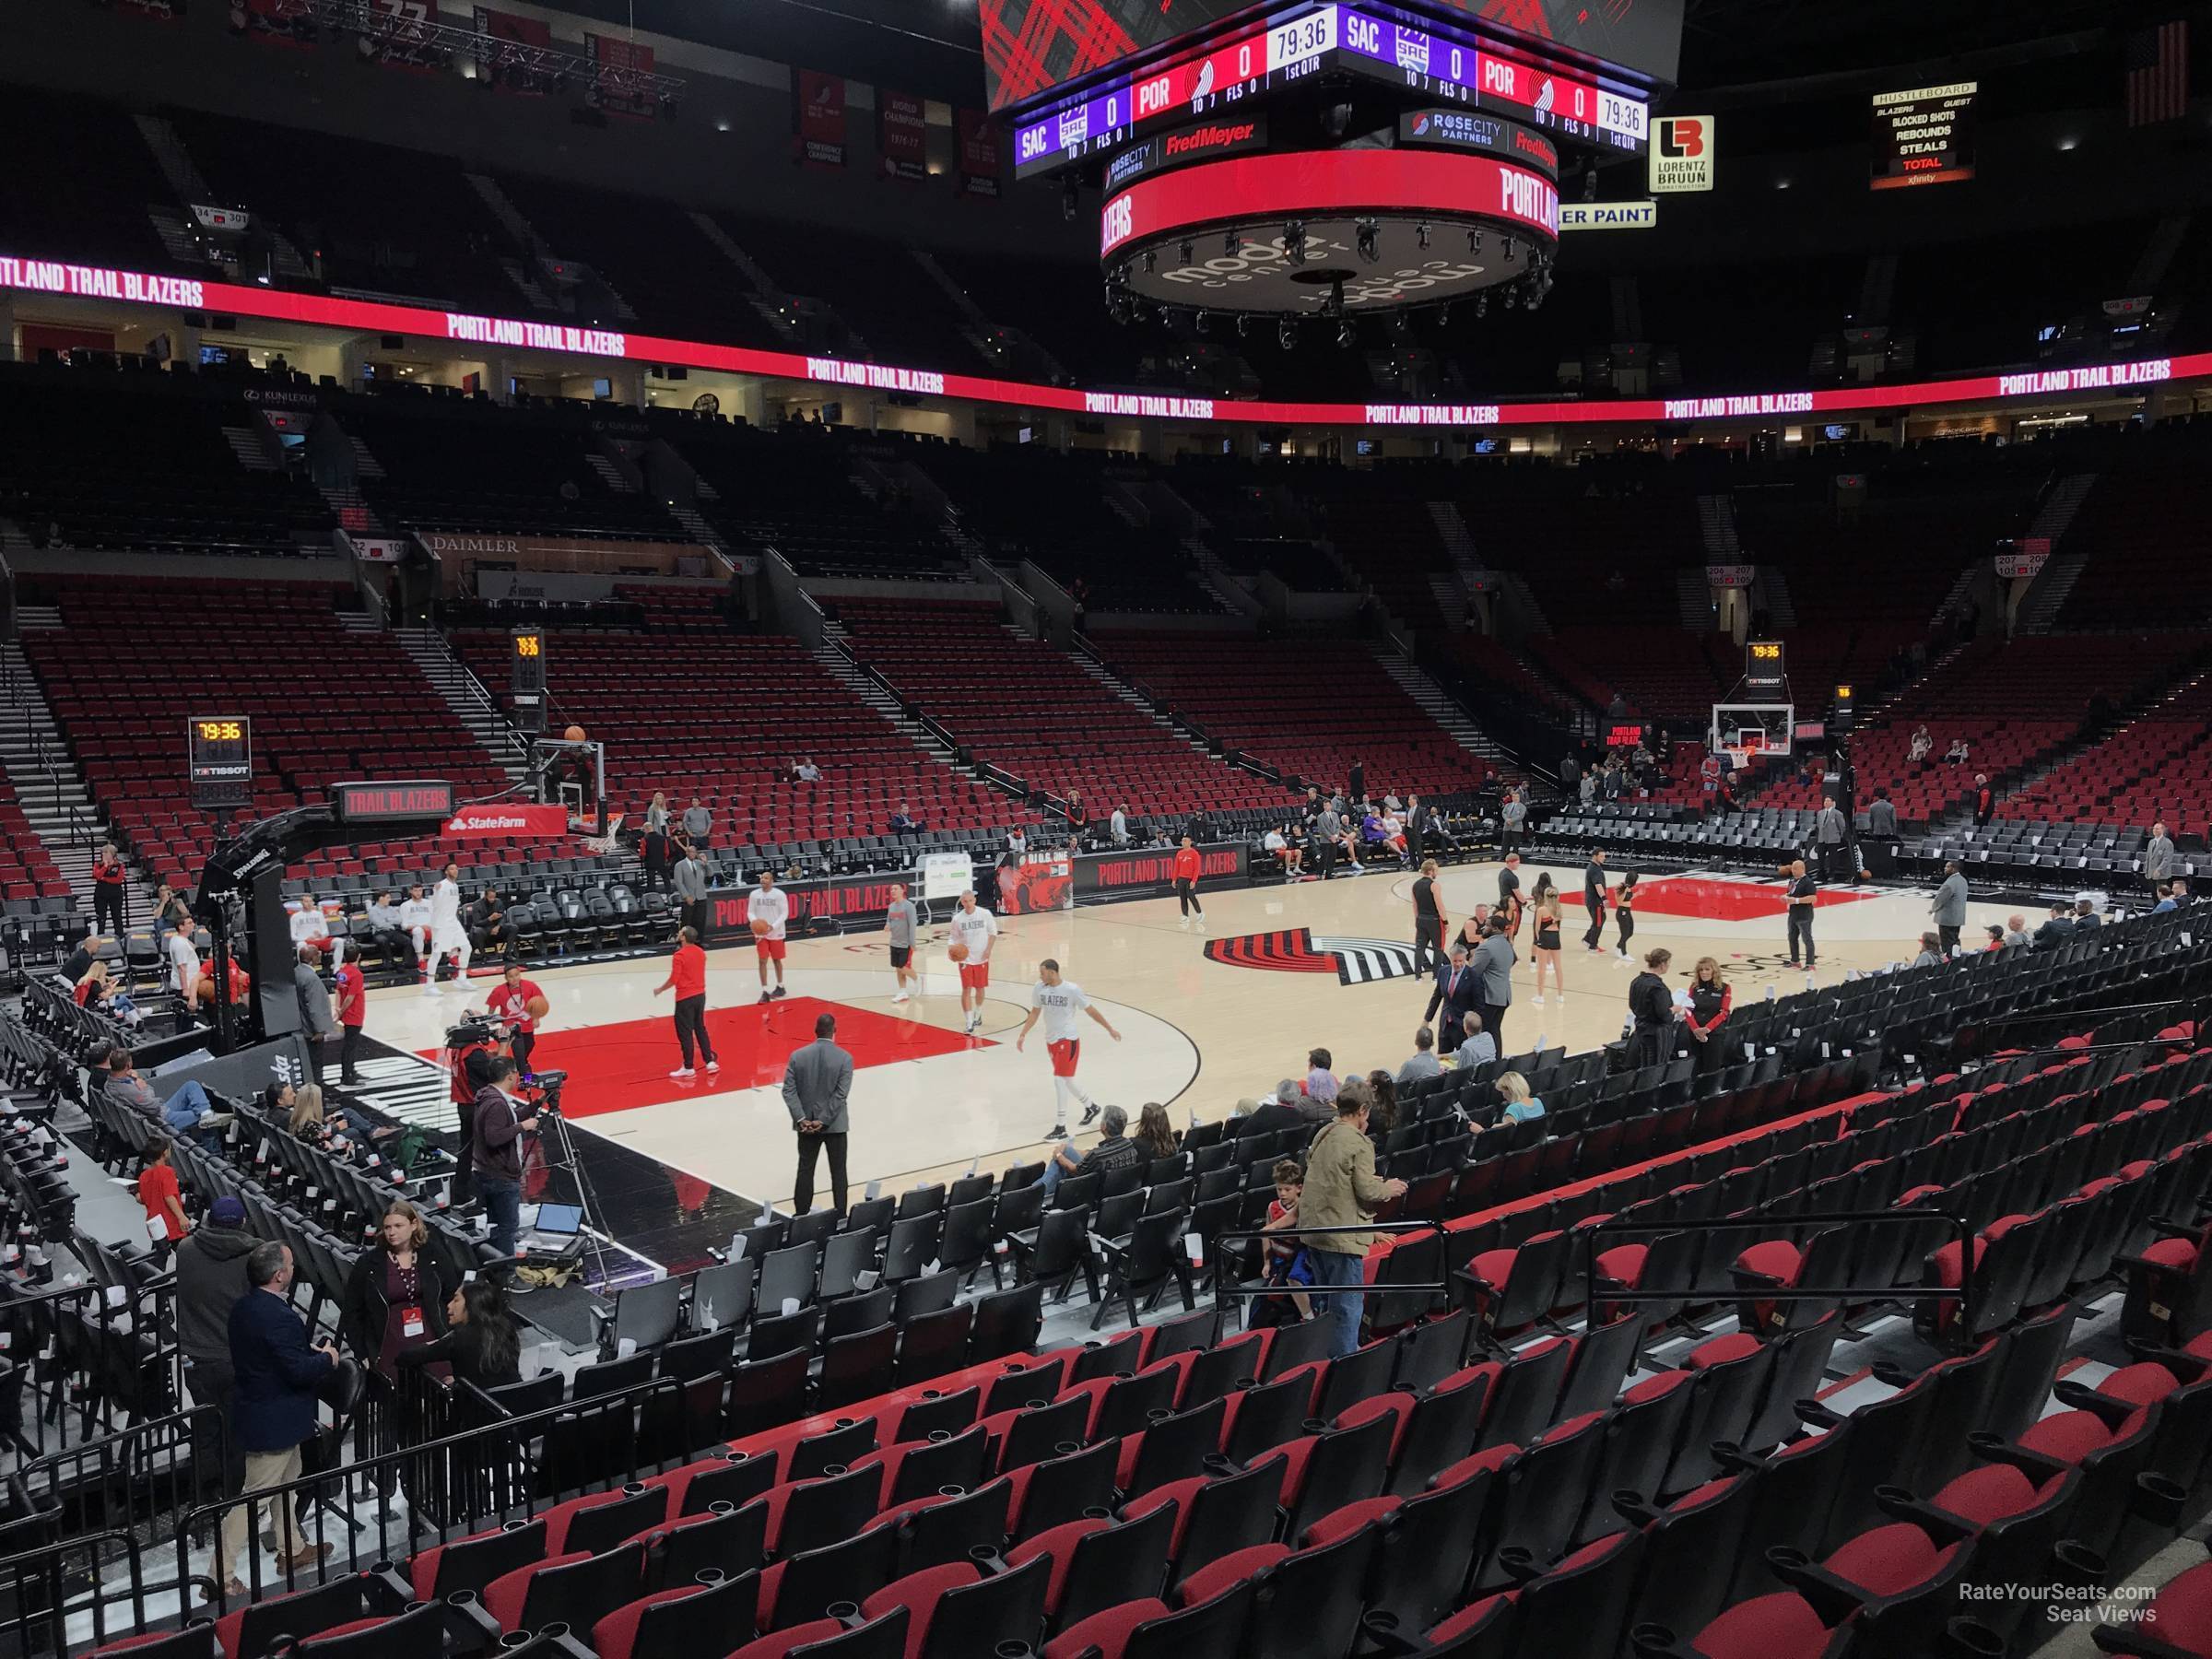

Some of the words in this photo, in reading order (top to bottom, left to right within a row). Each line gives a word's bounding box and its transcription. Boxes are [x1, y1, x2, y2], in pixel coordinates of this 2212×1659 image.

[1347, 17, 1379, 53] SAC
[1451, 49, 1462, 80] 0
[1485, 60, 1514, 95] POR
[1574, 88, 1584, 118] 0
[1605, 99, 1640, 131] 79:36
[1022, 126, 1047, 159] SAC
[1107, 97, 1117, 127] 0
[1139, 78, 1170, 115] POR
[1239, 46, 1251, 77] 0
[1277, 18, 1326, 60] 79:36
[1880, 84, 1970, 103] HUSTLEBOARD
[1067, 143, 1078, 160] TO
[1083, 140, 1088, 155] 7
[1097, 134, 1112, 149] FLS
[1116, 128, 1123, 142] 0
[1193, 98, 1204, 113] TO
[1210, 94, 1216, 108] 7
[1227, 84, 1243, 102] FLS
[1250, 79, 1256, 93] 0
[1285, 64, 1300, 81] 1st
[1300, 56, 1320, 76] QTR
[1406, 69, 1417, 87] TO
[1423, 76, 1429, 90] 7
[1440, 80, 1454, 98] FLS
[1461, 87, 1467, 102] 0
[1535, 110, 1545, 124] TO
[1551, 113, 1556, 127] 7
[1564, 118, 1578, 135] FLS
[1583, 124, 1590, 137] 0
[1877, 105, 1914, 116] BLAZERS
[1943, 98, 1971, 108] GUEST
[1892, 114, 1928, 127] BLOCKED
[1929, 111, 1955, 124] SHOTS
[1442, 129, 1492, 146] PARTNERS
[1896, 125, 1951, 141] REBOUNDS
[1900, 140, 1947, 155] STEALS
[1113, 160, 1144, 183] PARTNERS
[1659, 161, 1705, 172] LORENTZ
[1903, 158, 1942, 170] TOTAL
[1658, 172, 1705, 184] BRUUN
[1908, 173, 1936, 185] xfinity
[229, 213, 246, 222] 301
[1559, 210, 1587, 224] ER
[1594, 208, 1653, 223] PAINT
[0, 257, 65, 291] TLAND
[66, 265, 123, 298] TRAIL
[123, 272, 203, 307] BLAZERS
[446, 313, 524, 345] PORTLAND
[524, 322, 565, 349] TRAIL
[564, 327, 625, 357] BLAZERS
[806, 358, 865, 384] PORTLAND
[865, 365, 898, 389] TRAIL
[898, 369, 944, 394] BLAZERS
[1999, 371, 2069, 395] PORTLAND
[2071, 366, 2110, 389] TRAIL
[2111, 359, 2171, 385] BLAZERS
[1085, 393, 1139, 414] PORTLAND
[1138, 396, 1169, 416] TRAIL
[1169, 398, 1213, 418] BLAZERS
[1665, 398, 1725, 418] PORTLAND
[1726, 395, 1760, 415] TRAIL
[1760, 393, 1813, 413] BLAZERS
[1365, 405, 1420, 424] PORTLAND
[1421, 406, 1451, 424] TRAIL
[1452, 405, 1499, 424] BLAZERS
[432, 536, 521, 553] DAIMLER
[2000, 567, 2016, 575] 105
[1753, 645, 1779, 657] 79:36
[198, 723, 241, 739] 79:36
[209, 767, 248, 775] TISSOT
[347, 792, 387, 813] TRAIL
[387, 790, 448, 811] BLAZERS
[232, 848, 271, 880] SPALDING
[1053, 851, 1068, 862] ONE
[1098, 859, 1157, 887] PORTLAND
[1199, 852, 1237, 876] LAZERS
[526, 949, 657, 966] TOYOTA
[1040, 994, 1068, 1006] BLAZERS
[270, 1053, 291, 1084] ska
